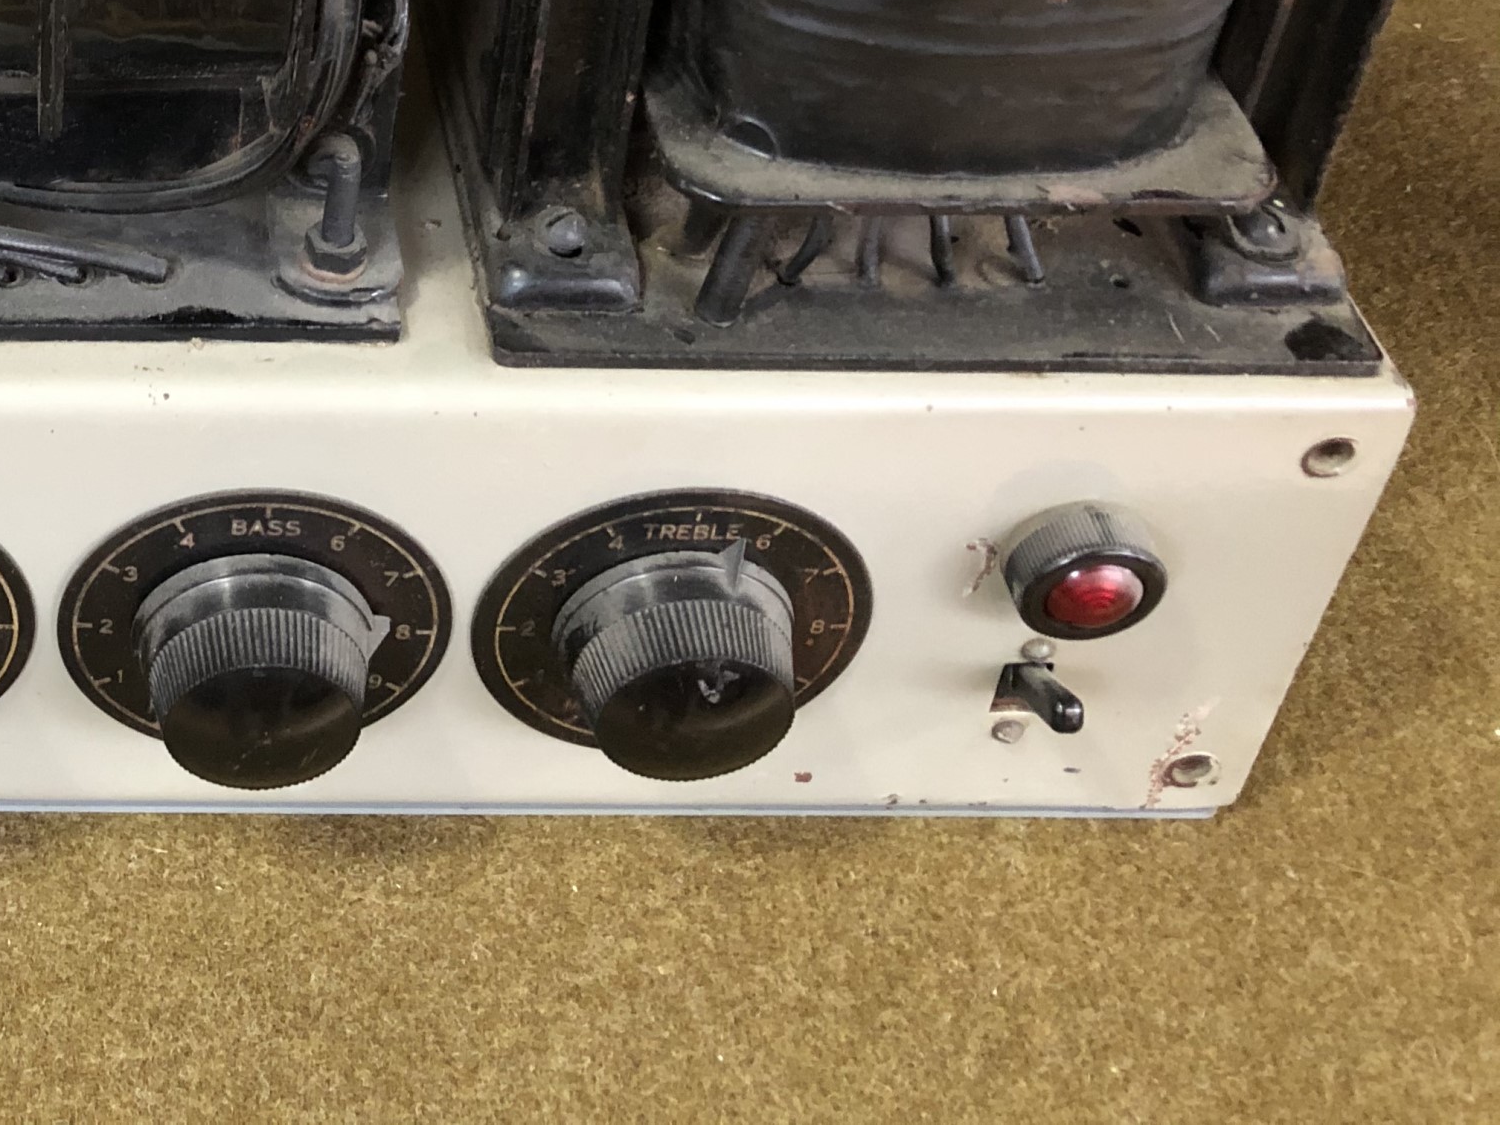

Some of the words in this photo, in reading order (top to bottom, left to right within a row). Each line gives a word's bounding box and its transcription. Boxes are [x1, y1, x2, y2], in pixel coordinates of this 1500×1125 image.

[231, 520, 301, 537] BASS
[643, 523, 743, 542] TREBLE
[179, 534, 195, 549] 4
[330, 535, 346, 550] 6
[755, 533, 773, 550] 6
[122, 566, 138, 582] 3
[384, 571, 399, 587] 7
[551, 569, 567, 587] 3
[99, 620, 114, 635] 2
[395, 624, 411, 639] 8
[810, 619, 825, 634] 8
[116, 669, 124, 683] 1
[368, 673, 382, 688] 9
